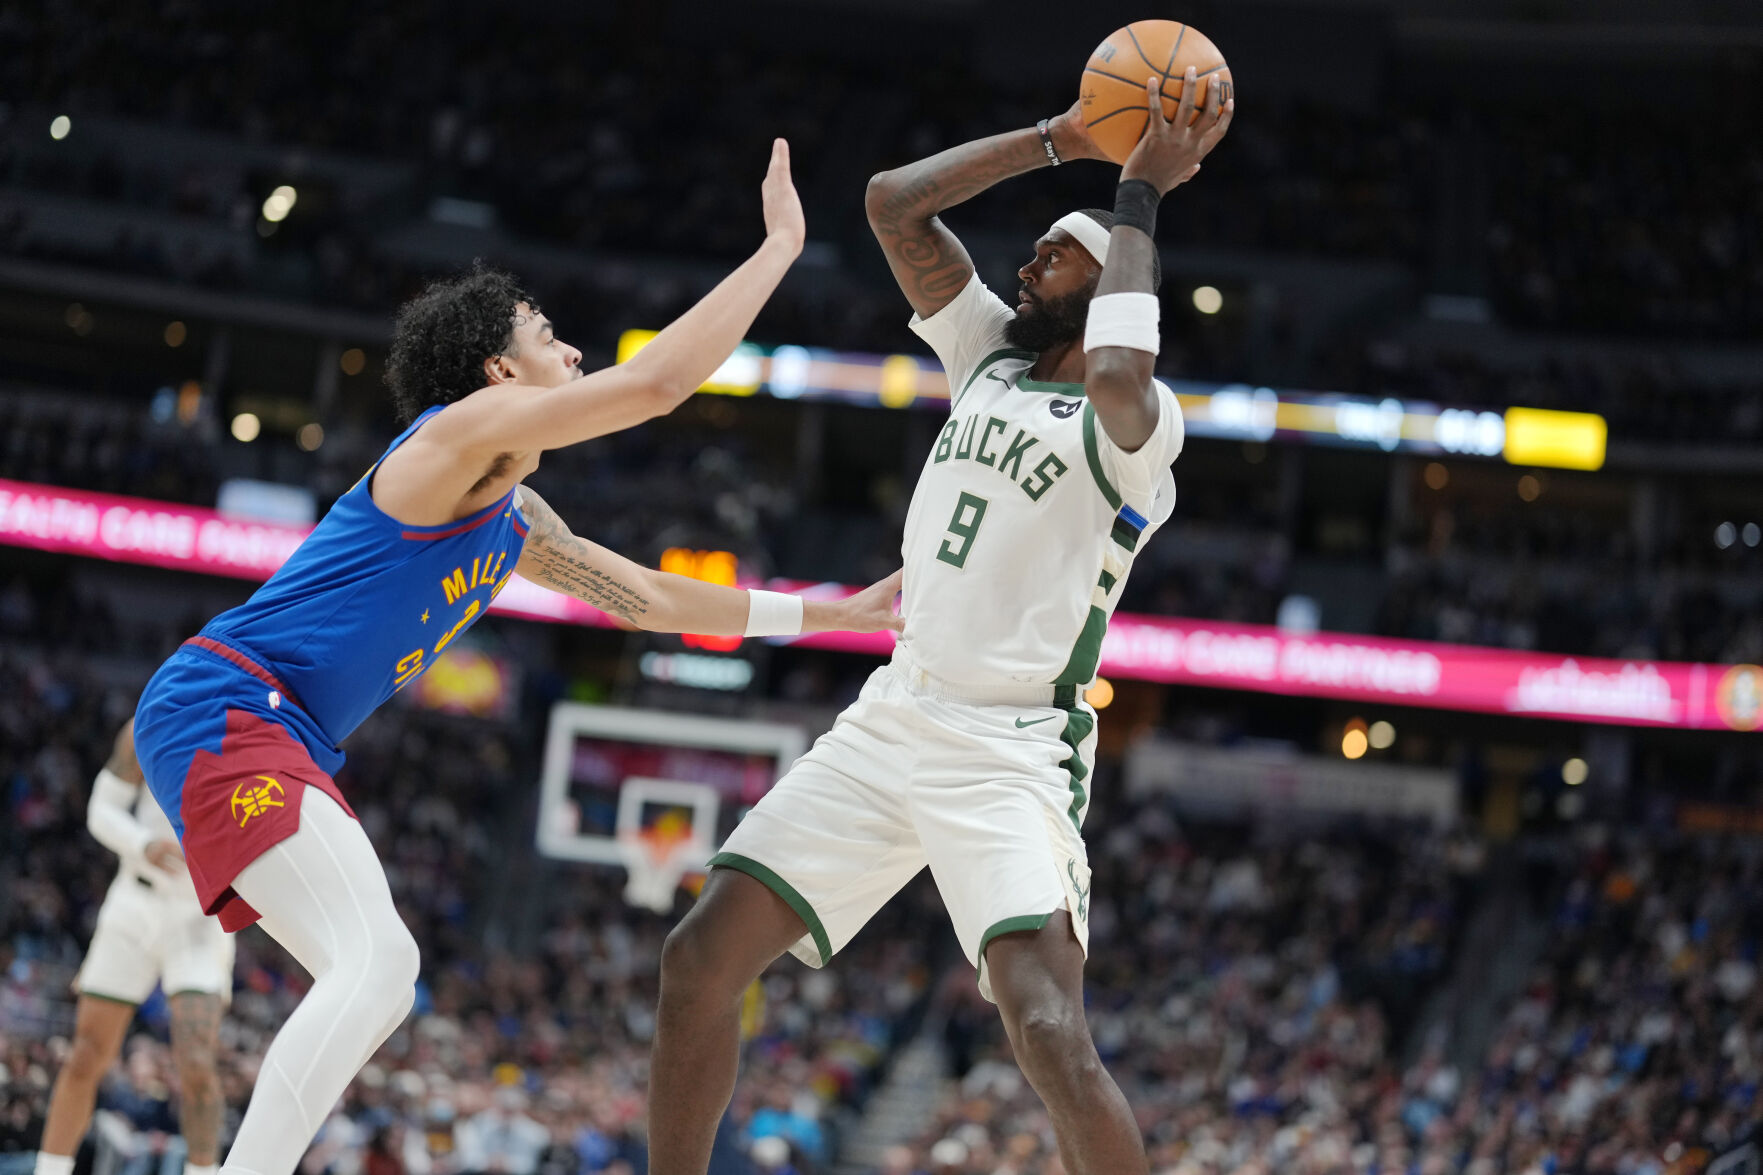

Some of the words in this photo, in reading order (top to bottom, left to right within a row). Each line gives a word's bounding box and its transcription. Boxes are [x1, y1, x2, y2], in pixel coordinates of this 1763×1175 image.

[933, 413, 1069, 503] BUCKS
[935, 490, 990, 570] 9
[441, 551, 507, 606] MILE
